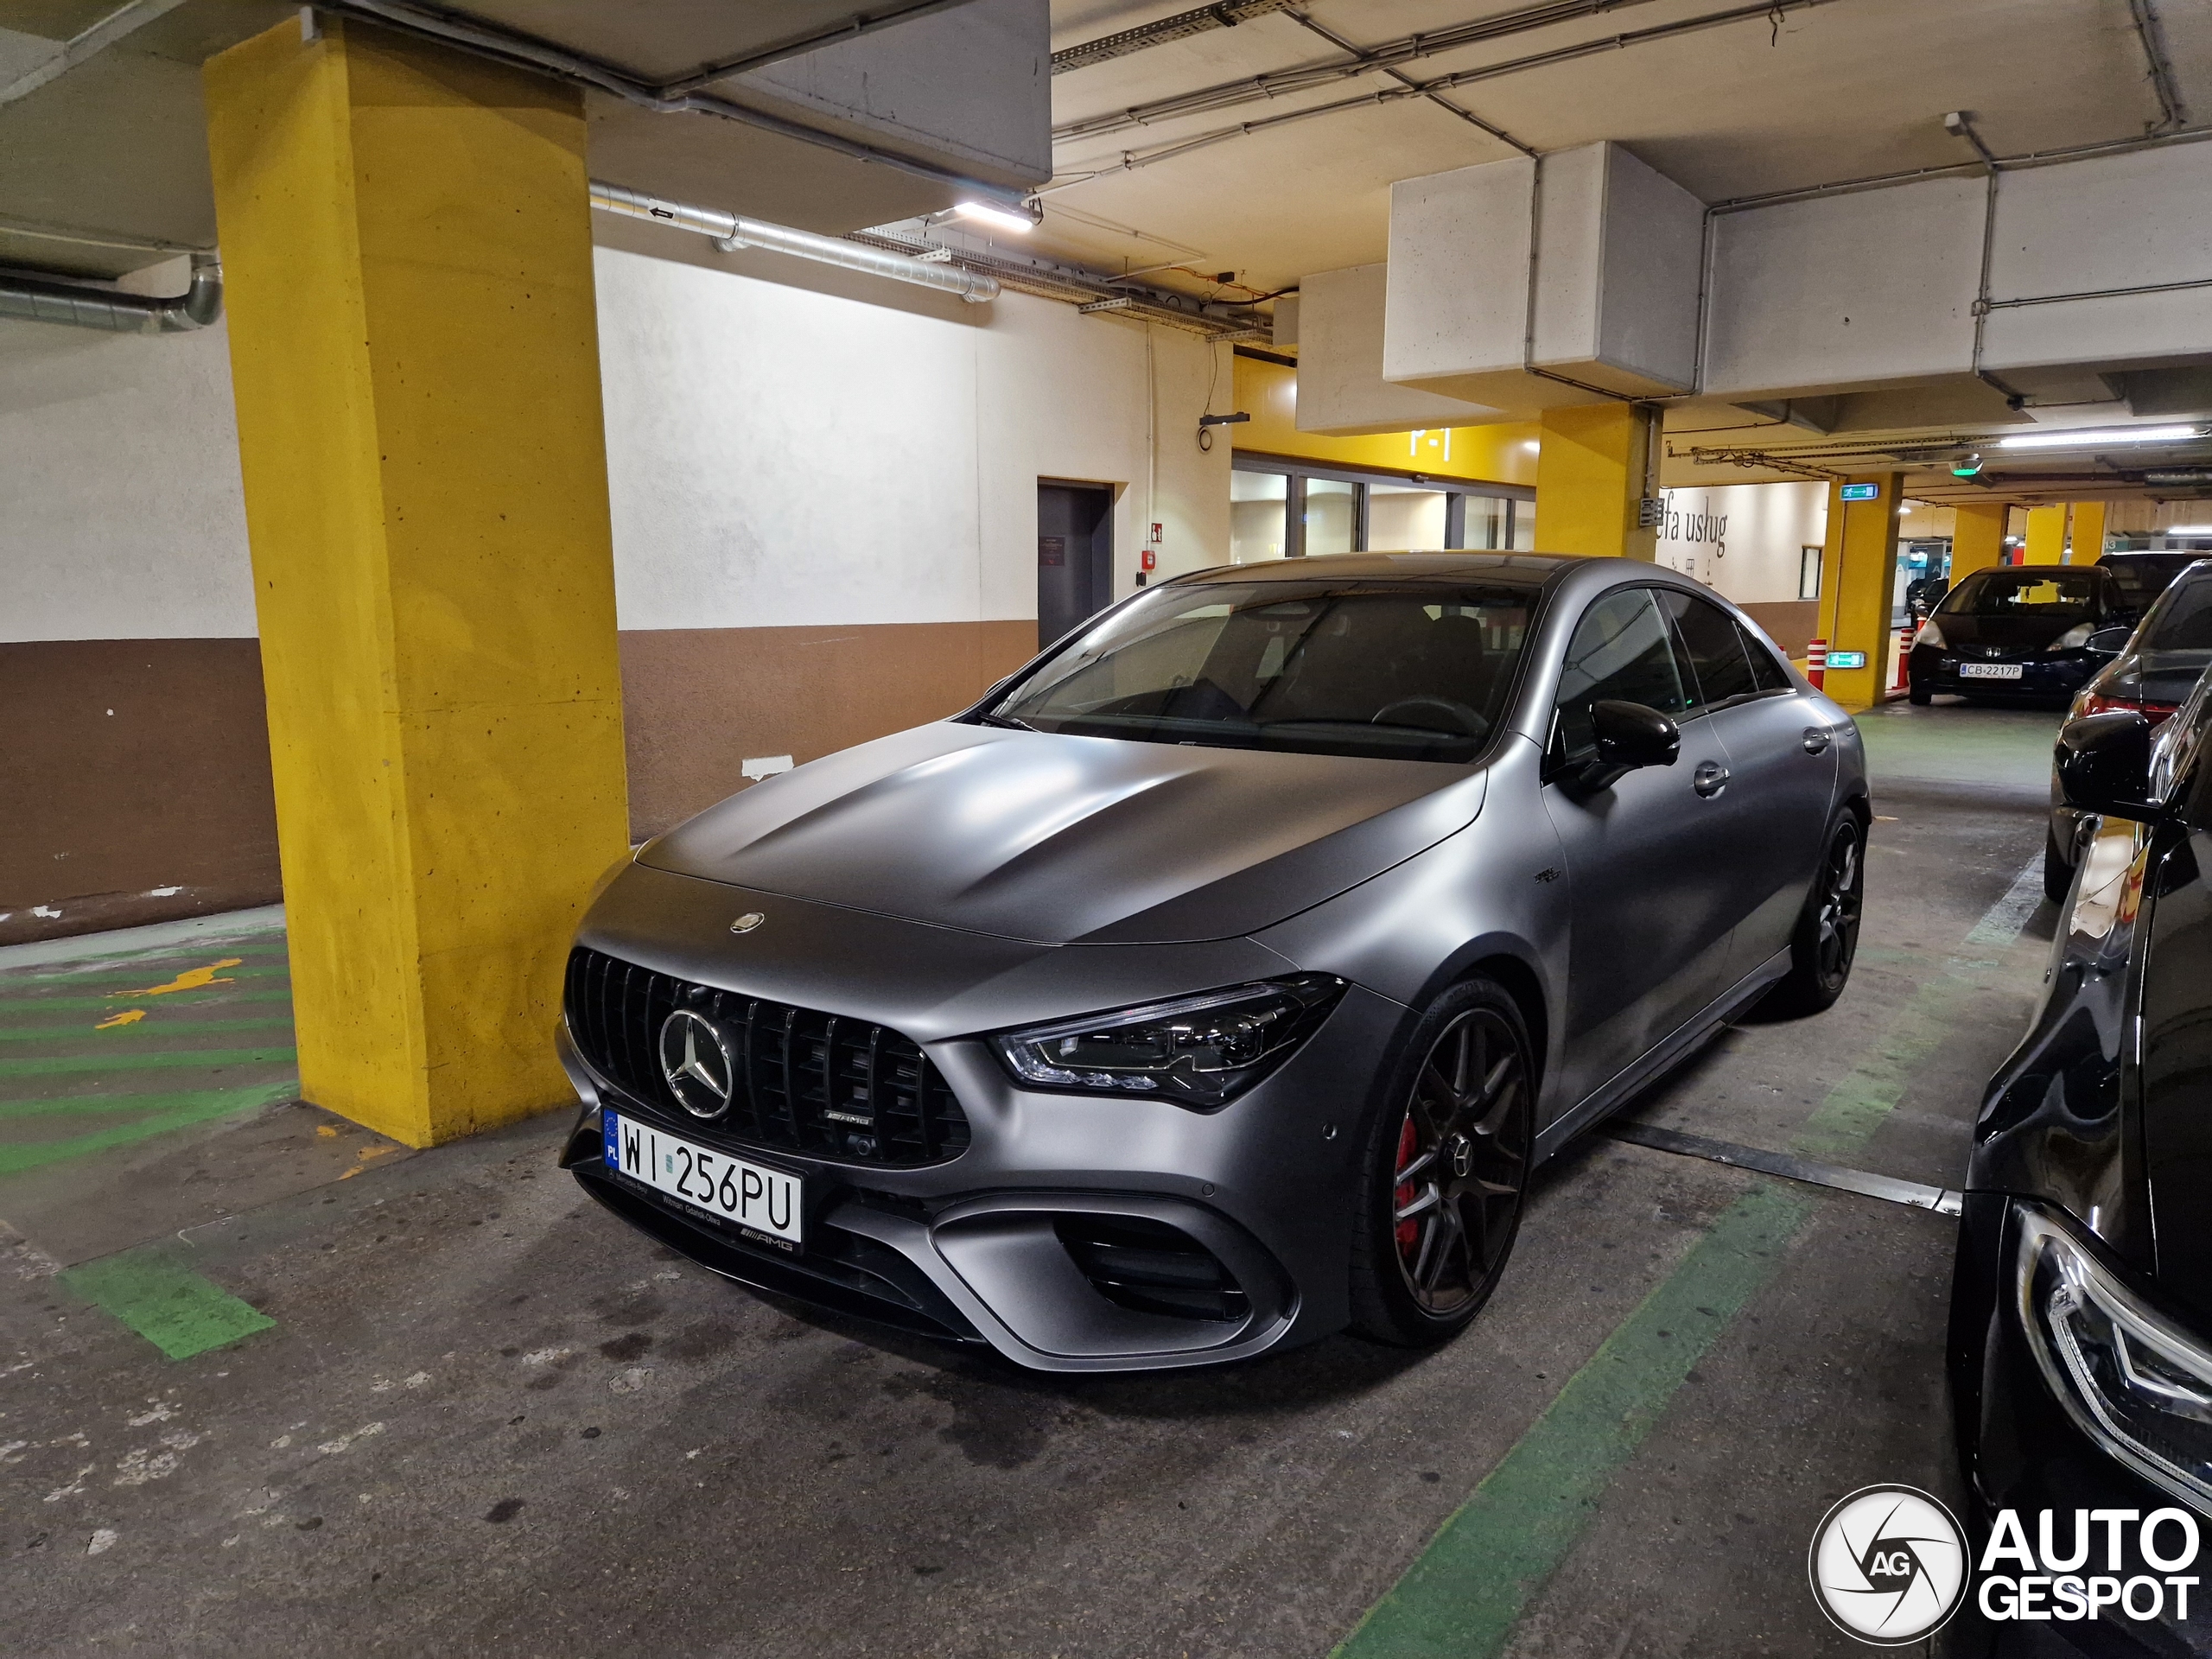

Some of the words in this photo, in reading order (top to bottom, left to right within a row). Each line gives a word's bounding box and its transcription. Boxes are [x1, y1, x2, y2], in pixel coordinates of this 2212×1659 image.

[1686, 495, 1728, 559] usług
[607, 1145, 618, 1161] PL
[624, 1123, 657, 1182] WI
[677, 1147, 791, 1230] 256PU
[756, 1234, 793, 1252] AMG
